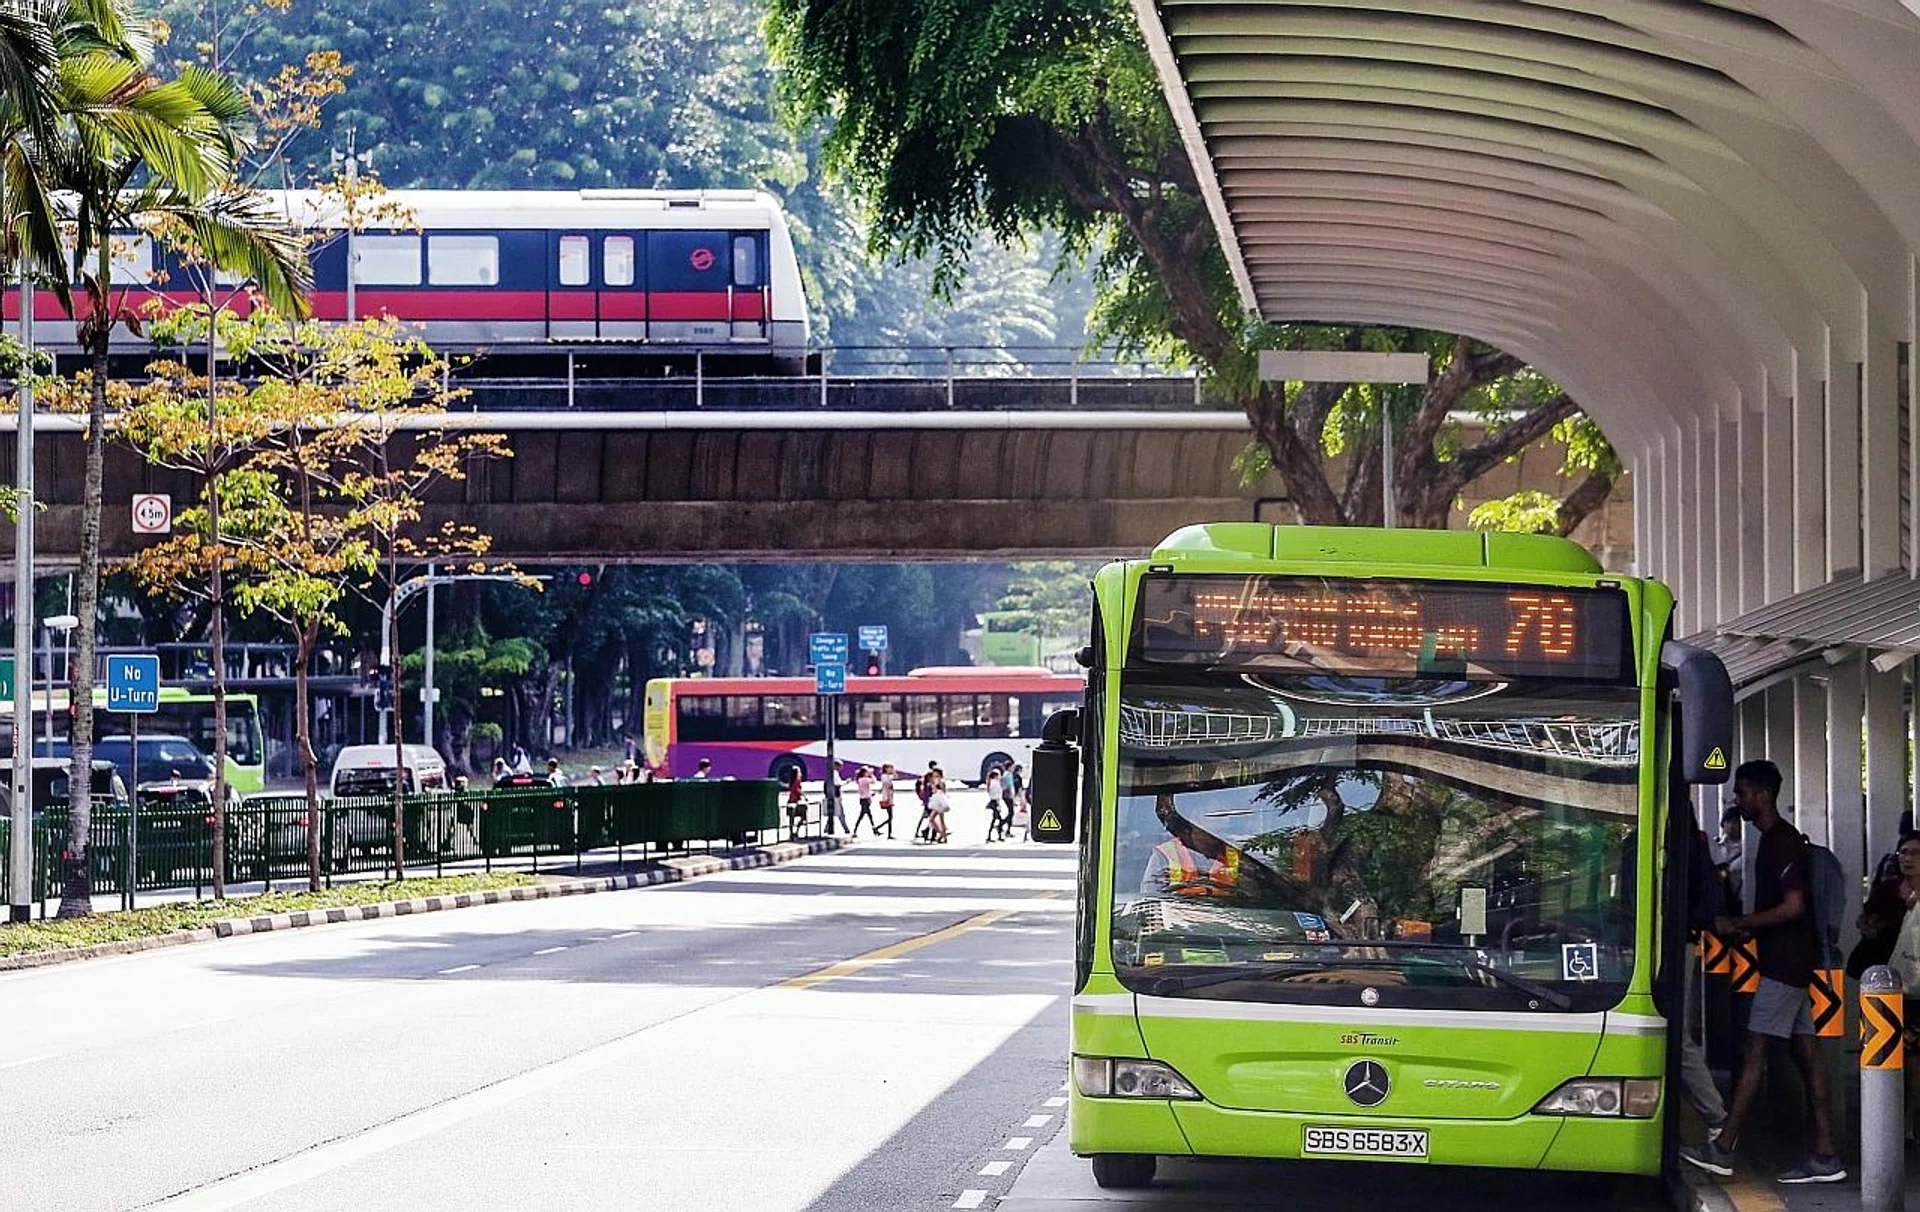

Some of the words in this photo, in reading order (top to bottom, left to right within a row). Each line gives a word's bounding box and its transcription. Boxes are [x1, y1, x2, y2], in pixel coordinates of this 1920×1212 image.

[1505, 595, 1574, 653] 70
[124, 664, 142, 681] No
[110, 686, 155, 703] U-Turn
[1340, 1034, 1359, 1045] SBS
[1357, 1032, 1400, 1046] Transit
